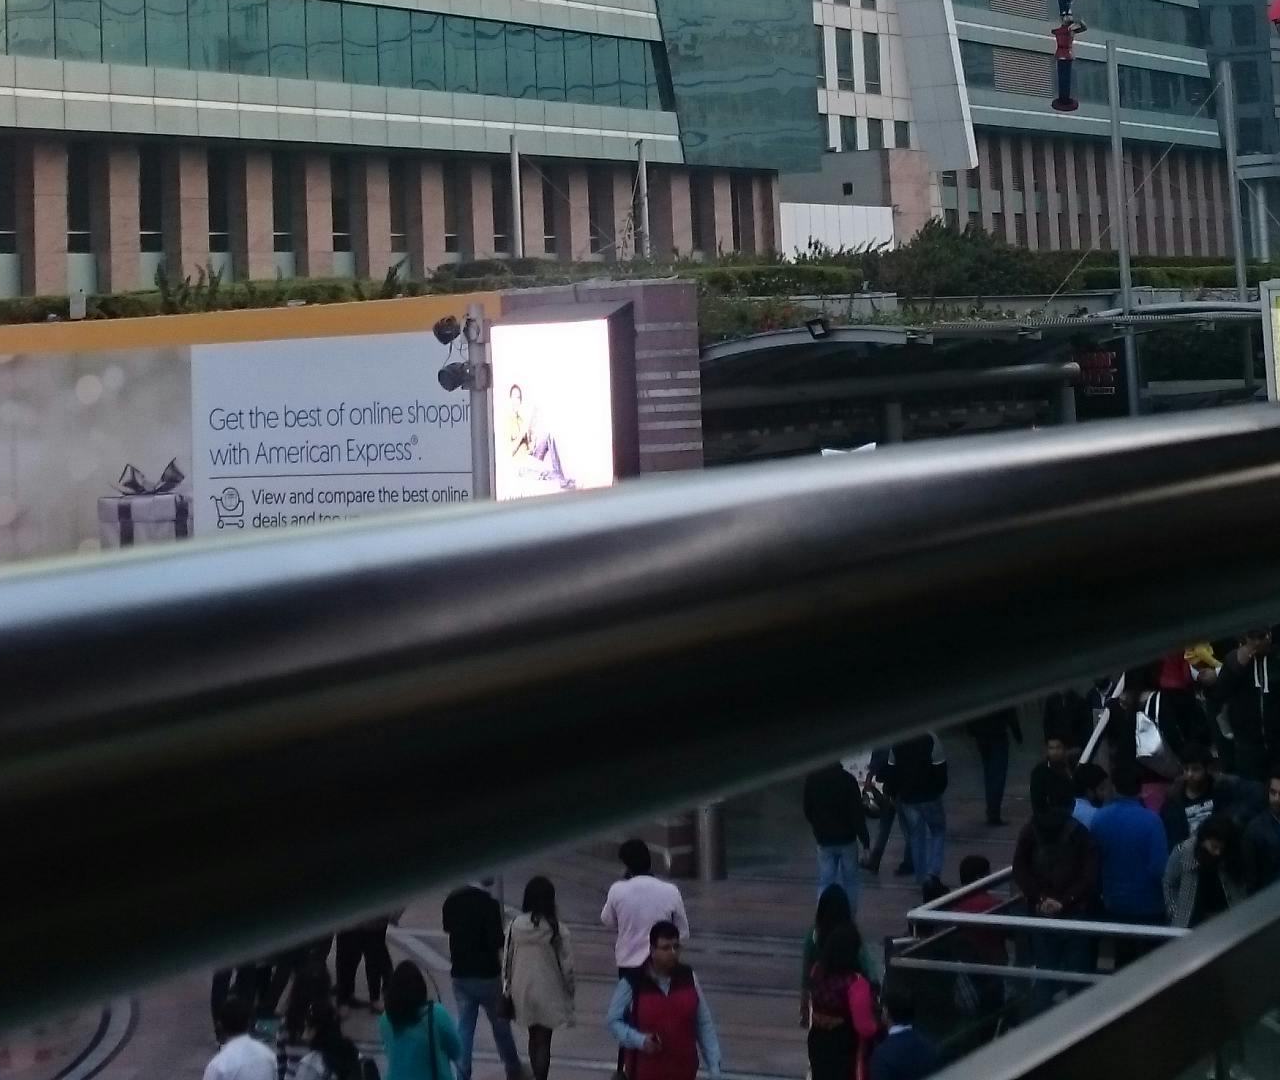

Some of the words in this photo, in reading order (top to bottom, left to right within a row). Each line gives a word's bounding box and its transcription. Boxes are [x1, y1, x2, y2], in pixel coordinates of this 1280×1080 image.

[209, 408, 244, 431] Get
[249, 406, 279, 429] the
[284, 404, 322, 428] best
[326, 402, 345, 427] of
[349, 401, 403, 426] online
[407, 399, 470, 429] shoppi
[209, 442, 249, 466] with
[255, 440, 341, 465] American
[251, 489, 286, 505] View
[289, 487, 314, 505] and
[317, 490, 375, 508] compare
[378, 486, 399, 503] the
[402, 486, 429, 503] best
[431, 485, 469, 503] online
[252, 511, 287, 529] deals
[290, 511, 316, 527] and
